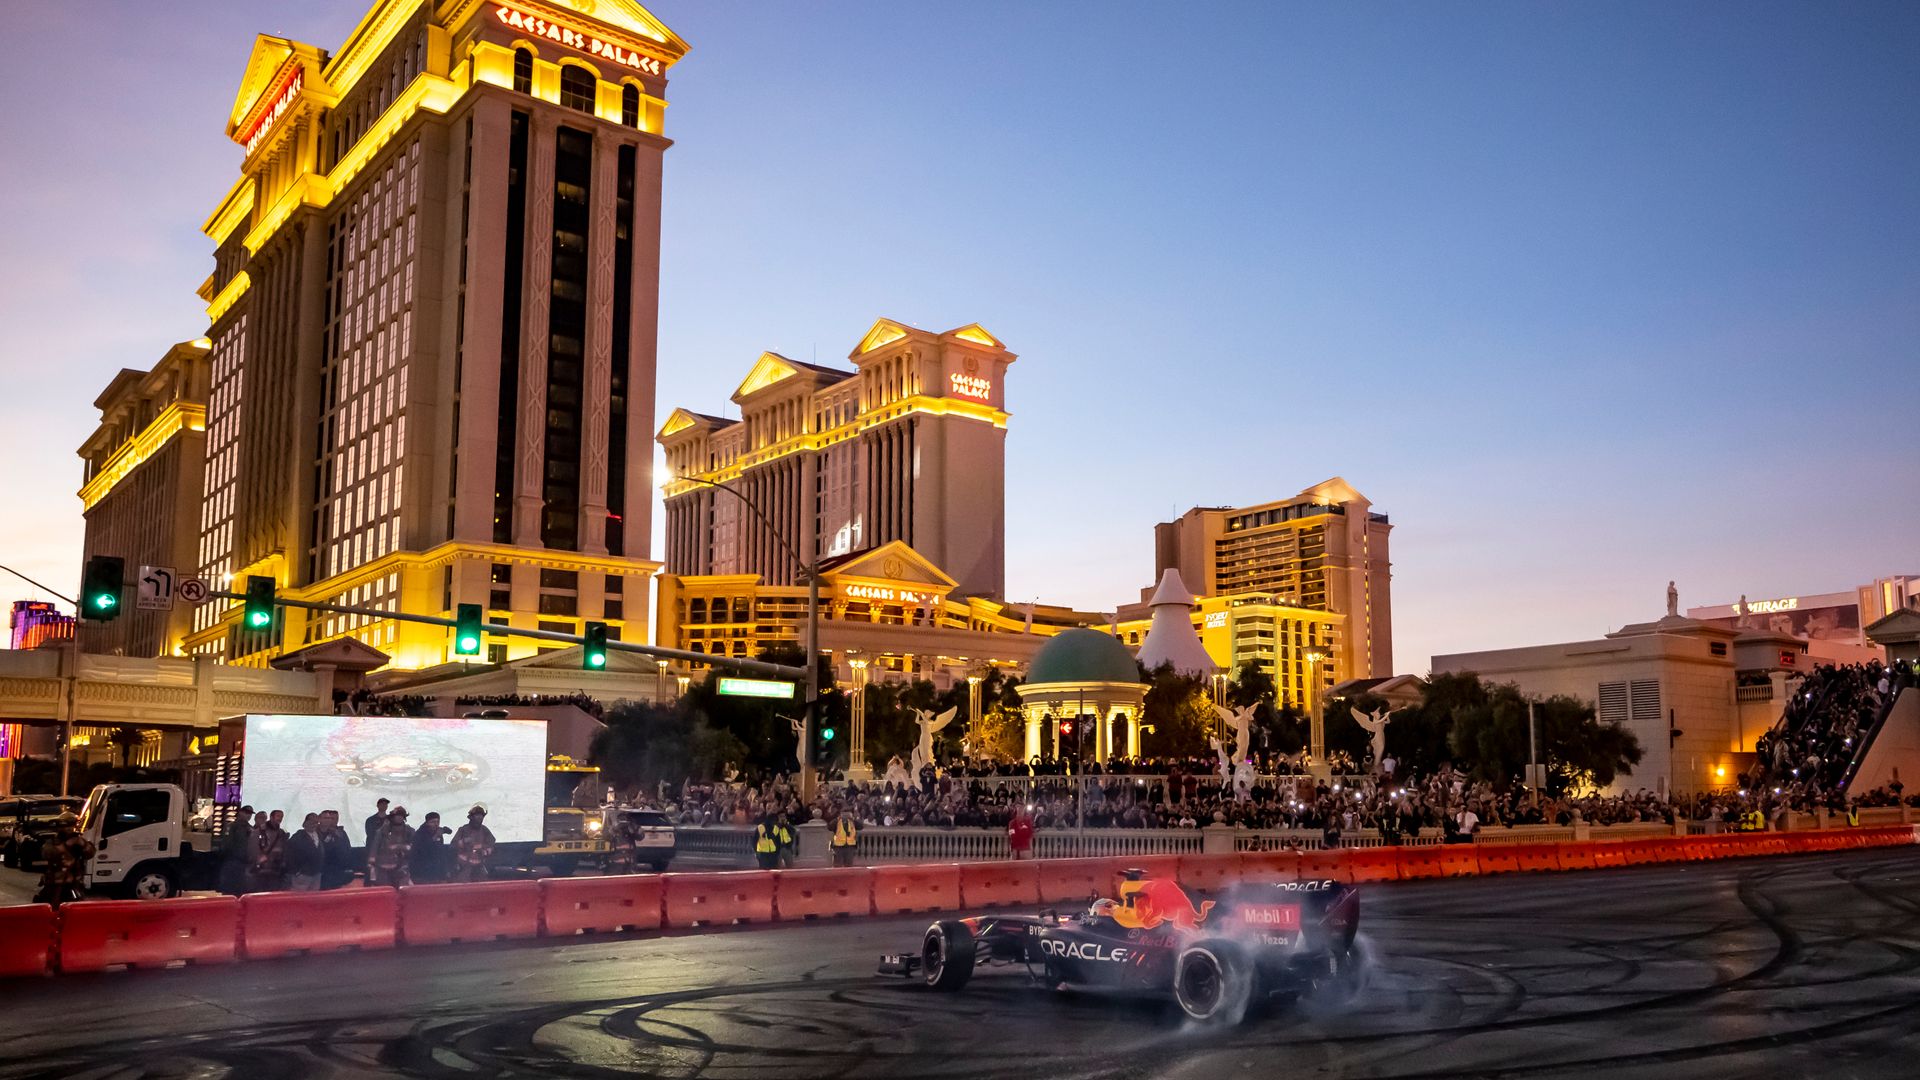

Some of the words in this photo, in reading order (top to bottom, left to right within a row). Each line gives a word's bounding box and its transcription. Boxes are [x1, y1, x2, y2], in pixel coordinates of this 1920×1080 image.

[496, 7, 585, 49] CAESARS
[591, 38, 660, 76] PALACE
[273, 73, 301, 122] PALACE
[951, 373, 991, 390] CAESARS
[953, 383, 989, 400] PALACE
[845, 585, 895, 600] CAESARS
[900, 591, 940, 605] PALE
[1747, 599, 1797, 612] MIRAGE
[1274, 879, 1332, 892] ORACLE
[1245, 909, 1280, 924] Mobil
[1262, 934, 1289, 946] Tezos
[1040, 938, 1127, 962] ORACLE
